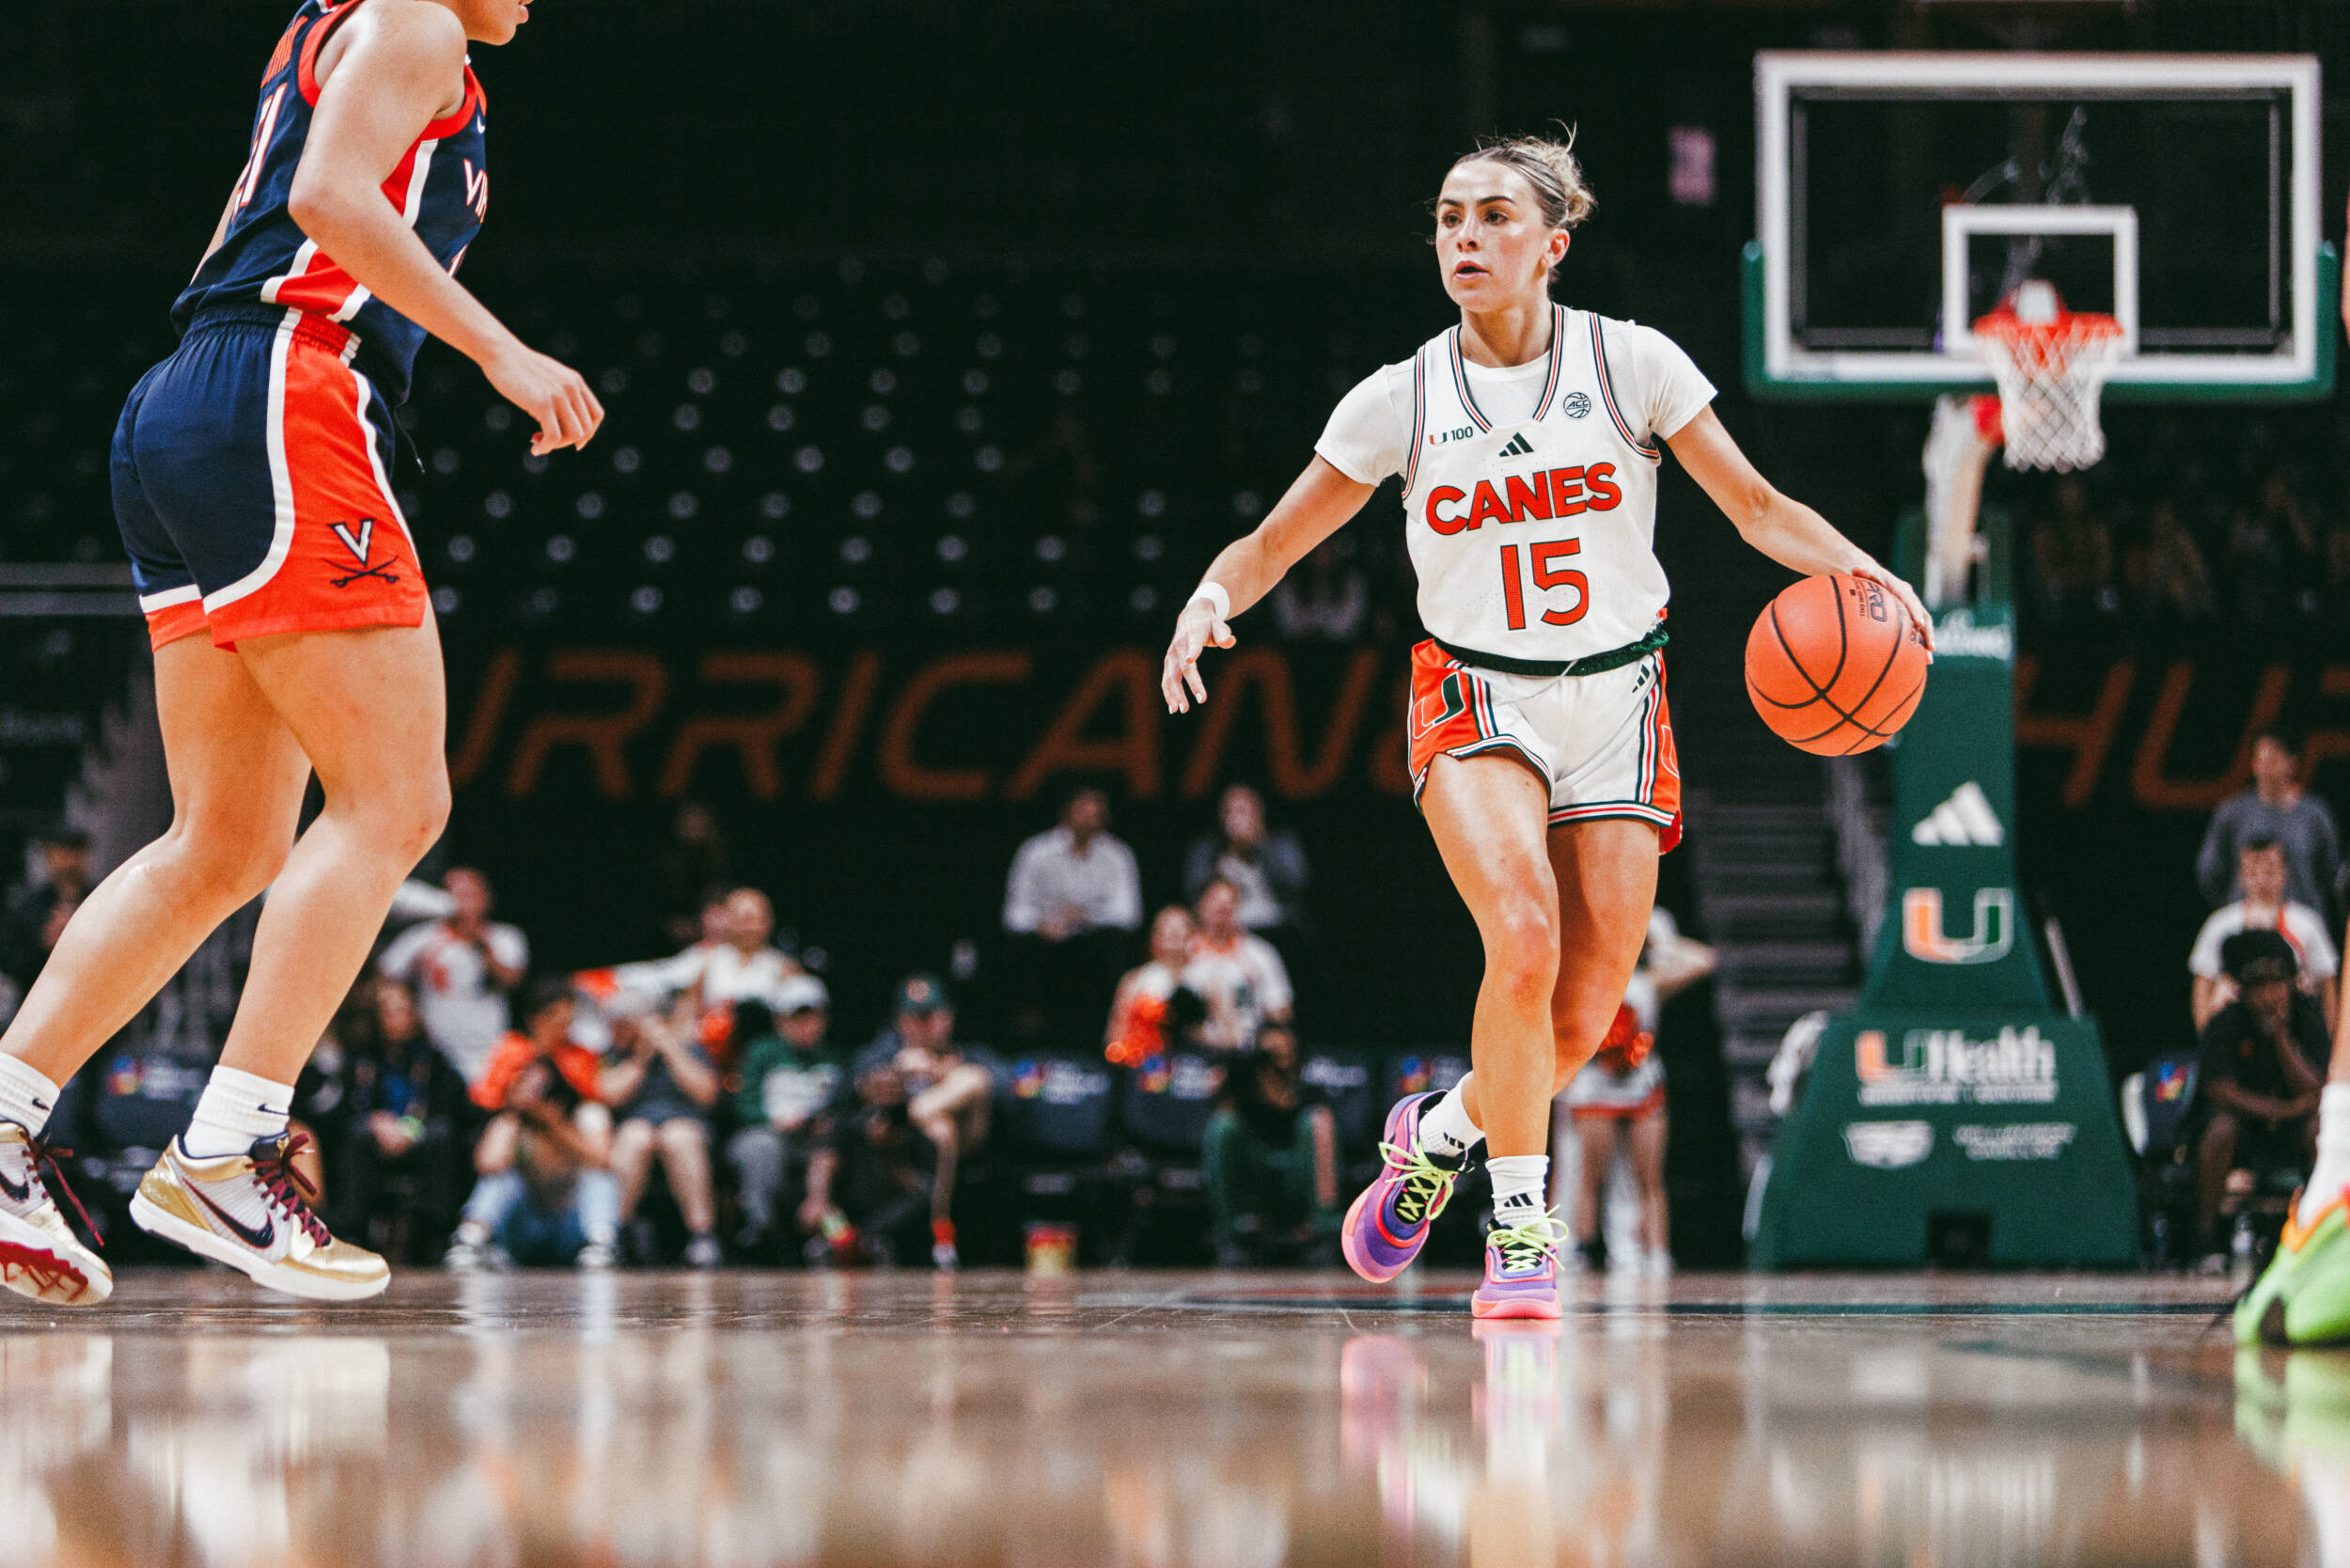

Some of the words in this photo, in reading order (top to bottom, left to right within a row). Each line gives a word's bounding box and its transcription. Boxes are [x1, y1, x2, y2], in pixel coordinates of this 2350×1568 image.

[1451, 426, 1474, 441] 100
[1566, 400, 1590, 409] ACC
[1426, 462, 1622, 536] CANES
[1500, 537, 1590, 631] 15
[1903, 887, 2013, 964] U
